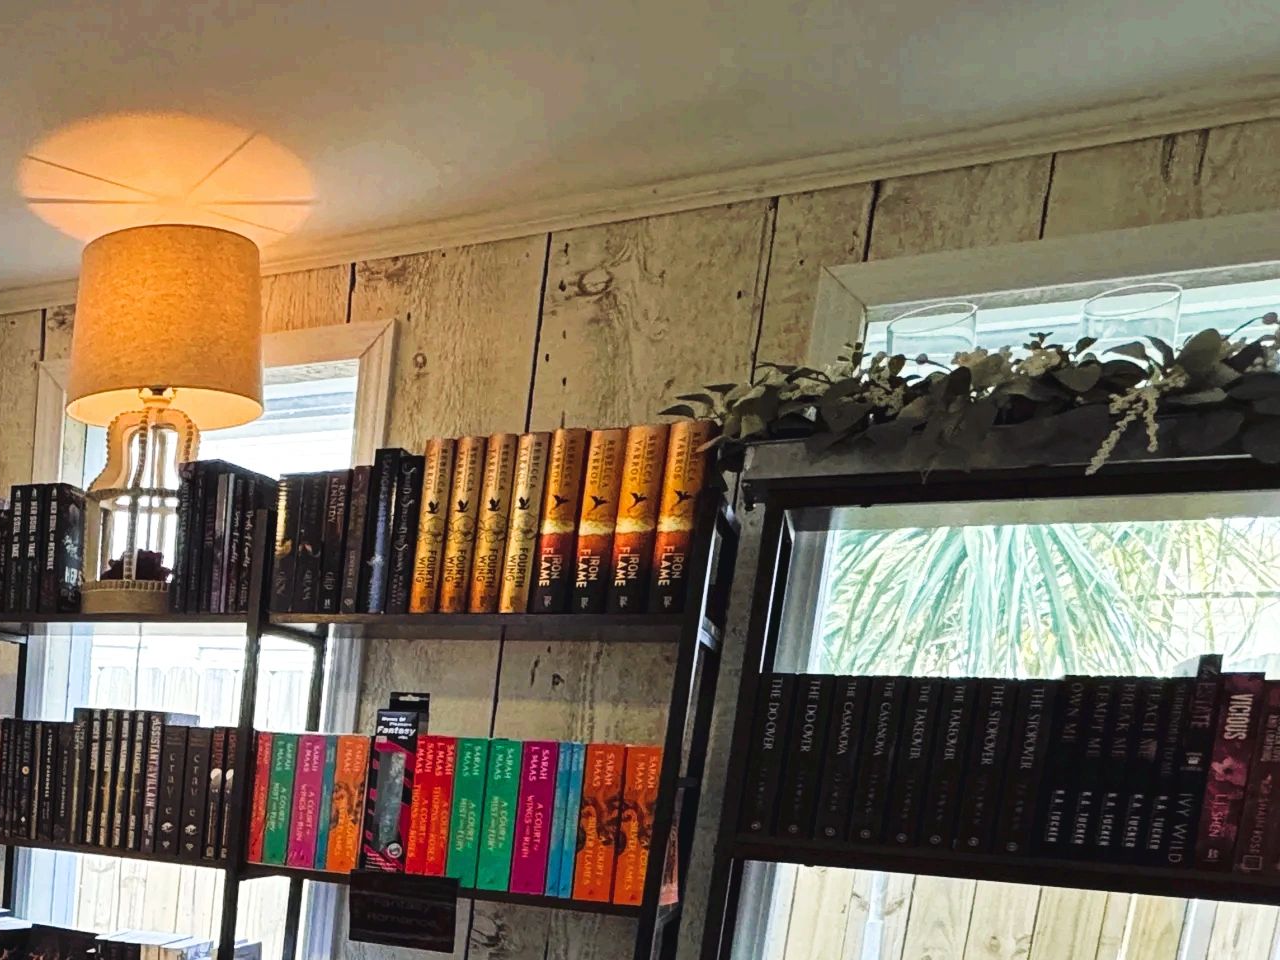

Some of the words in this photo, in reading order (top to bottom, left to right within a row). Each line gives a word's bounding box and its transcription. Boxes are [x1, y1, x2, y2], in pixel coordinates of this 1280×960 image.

[328, 478, 338, 523] KENNEDY
[12, 515, 21, 534] SOUL
[11, 543, 20, 558] TAKE
[415, 556, 425, 583] WING
[426, 549, 437, 589] FOURTH
[445, 556, 454, 583] WING
[455, 549, 467, 588] FOURTH
[476, 555, 487, 582] WING
[486, 548, 499, 587] FOURTH
[505, 554, 515, 582] WING
[515, 547, 529, 588] FOURTH
[538, 546, 554, 587] FLAME
[549, 553, 561, 580] IRON
[575, 548, 592, 589] FLAME
[588, 555, 601, 582] IRON
[614, 545, 630, 587] FLAME
[627, 552, 640, 580] IRON
[657, 546, 674, 587] FLAME
[671, 552, 684, 580] IRON
[376, 726, 417, 737] Fantasy
[836, 701, 855, 755] CASANOVA
[873, 701, 892, 757] CASANOVA
[909, 706, 929, 761] TAKEOVER
[943, 708, 962, 761] TAKEOVER
[1223, 693, 1254, 740] VICIOUS
[149, 717, 161, 765] ASSISTANT
[981, 709, 1001, 766] STOPOVER
[1020, 714, 1041, 770] STOPOVER
[145, 773, 159, 807] VILLAIN
[1176, 793, 1195, 818] IVY
[1167, 823, 1188, 863] WILD
